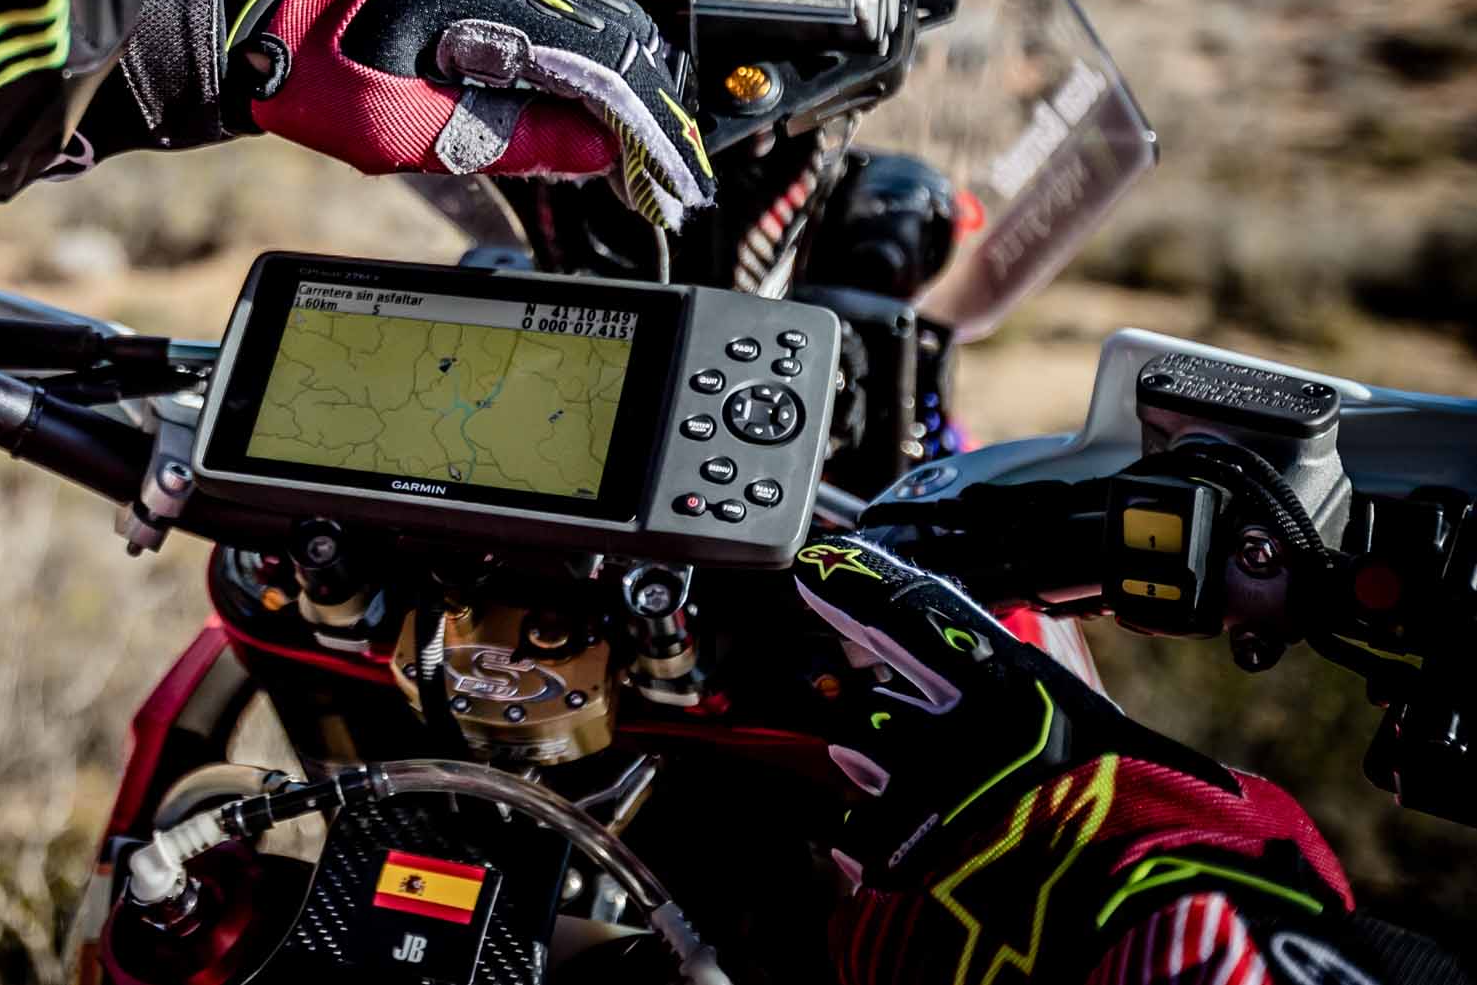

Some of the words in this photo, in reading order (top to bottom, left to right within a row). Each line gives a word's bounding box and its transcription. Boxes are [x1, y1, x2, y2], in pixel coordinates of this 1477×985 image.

[298, 283, 353, 300] Carretera
[356, 289, 374, 302] sin
[376, 292, 424, 307] asfaltar
[294, 297, 339, 312] 1.60km
[525, 303, 537, 316] N
[785, 333, 801, 342] OUT
[782, 360, 794, 369] IN
[708, 464, 730, 473] MENU
[392, 480, 446, 495] GARMIN
[1148, 535, 1156, 549] 1
[1147, 583, 1157, 596] 2
[392, 931, 428, 964] JB
